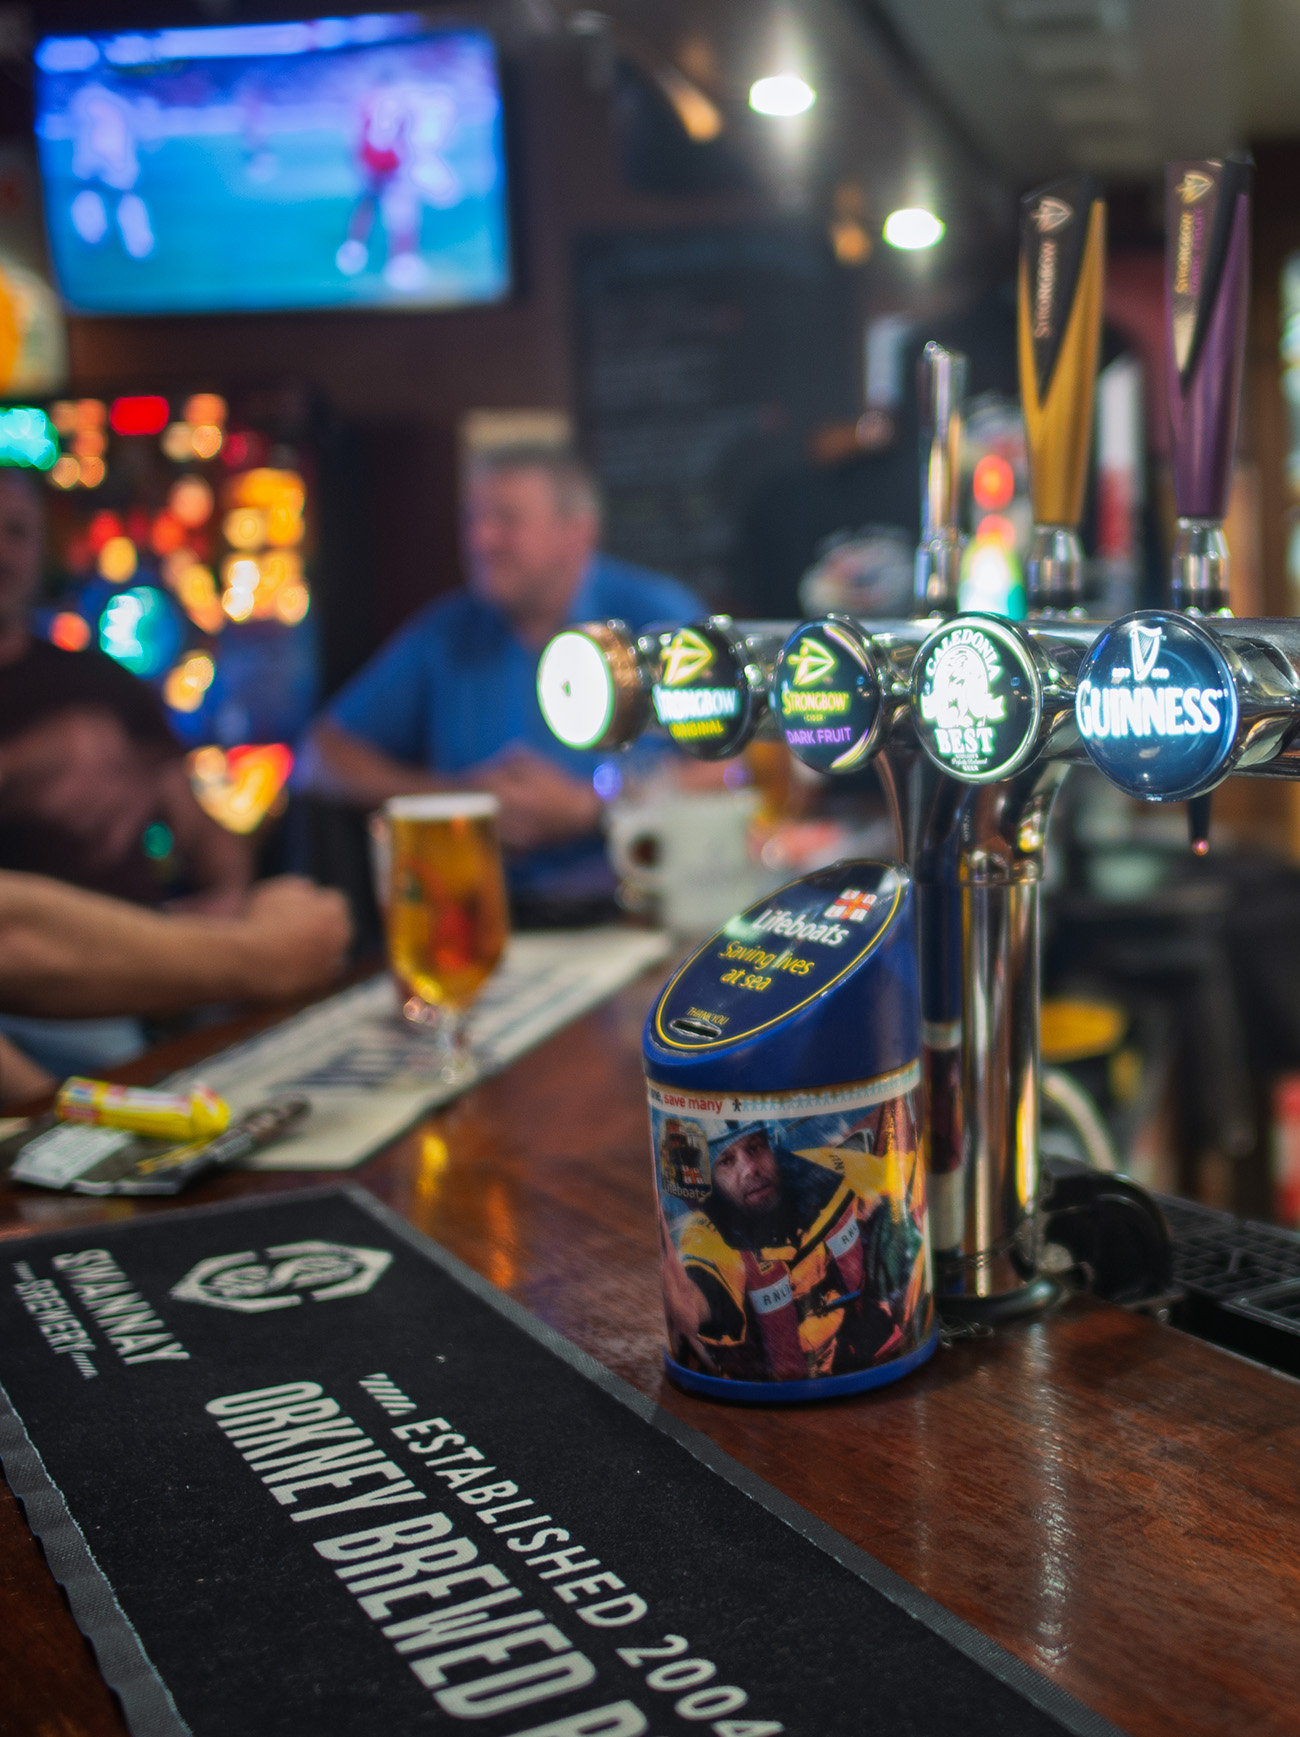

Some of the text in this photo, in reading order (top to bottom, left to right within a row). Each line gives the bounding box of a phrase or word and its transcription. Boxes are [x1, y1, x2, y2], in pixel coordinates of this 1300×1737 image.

[925, 628, 1002, 678] CALEDONIA
[783, 690, 847, 715] STRONGBOW
[1076, 679, 1222, 740] GUINNESS
[786, 727, 851, 746] DARK FRUIT
[934, 727, 993, 754] BEST
[752, 908, 849, 946] Lifeboats
[719, 941, 815, 976] Saving lives
[721, 968, 772, 992] at sea
[664, 1093, 685, 1108] save
[688, 1098, 723, 1115] many
[15, 1278, 97, 1354] BREWERY
[52, 1248, 191, 1365] SWANNAY
[205, 1380, 427, 1522] ORKNEY
[391, 1417, 648, 1628] ESTABLISHED
[313, 1511, 597, 1720] BREWED
